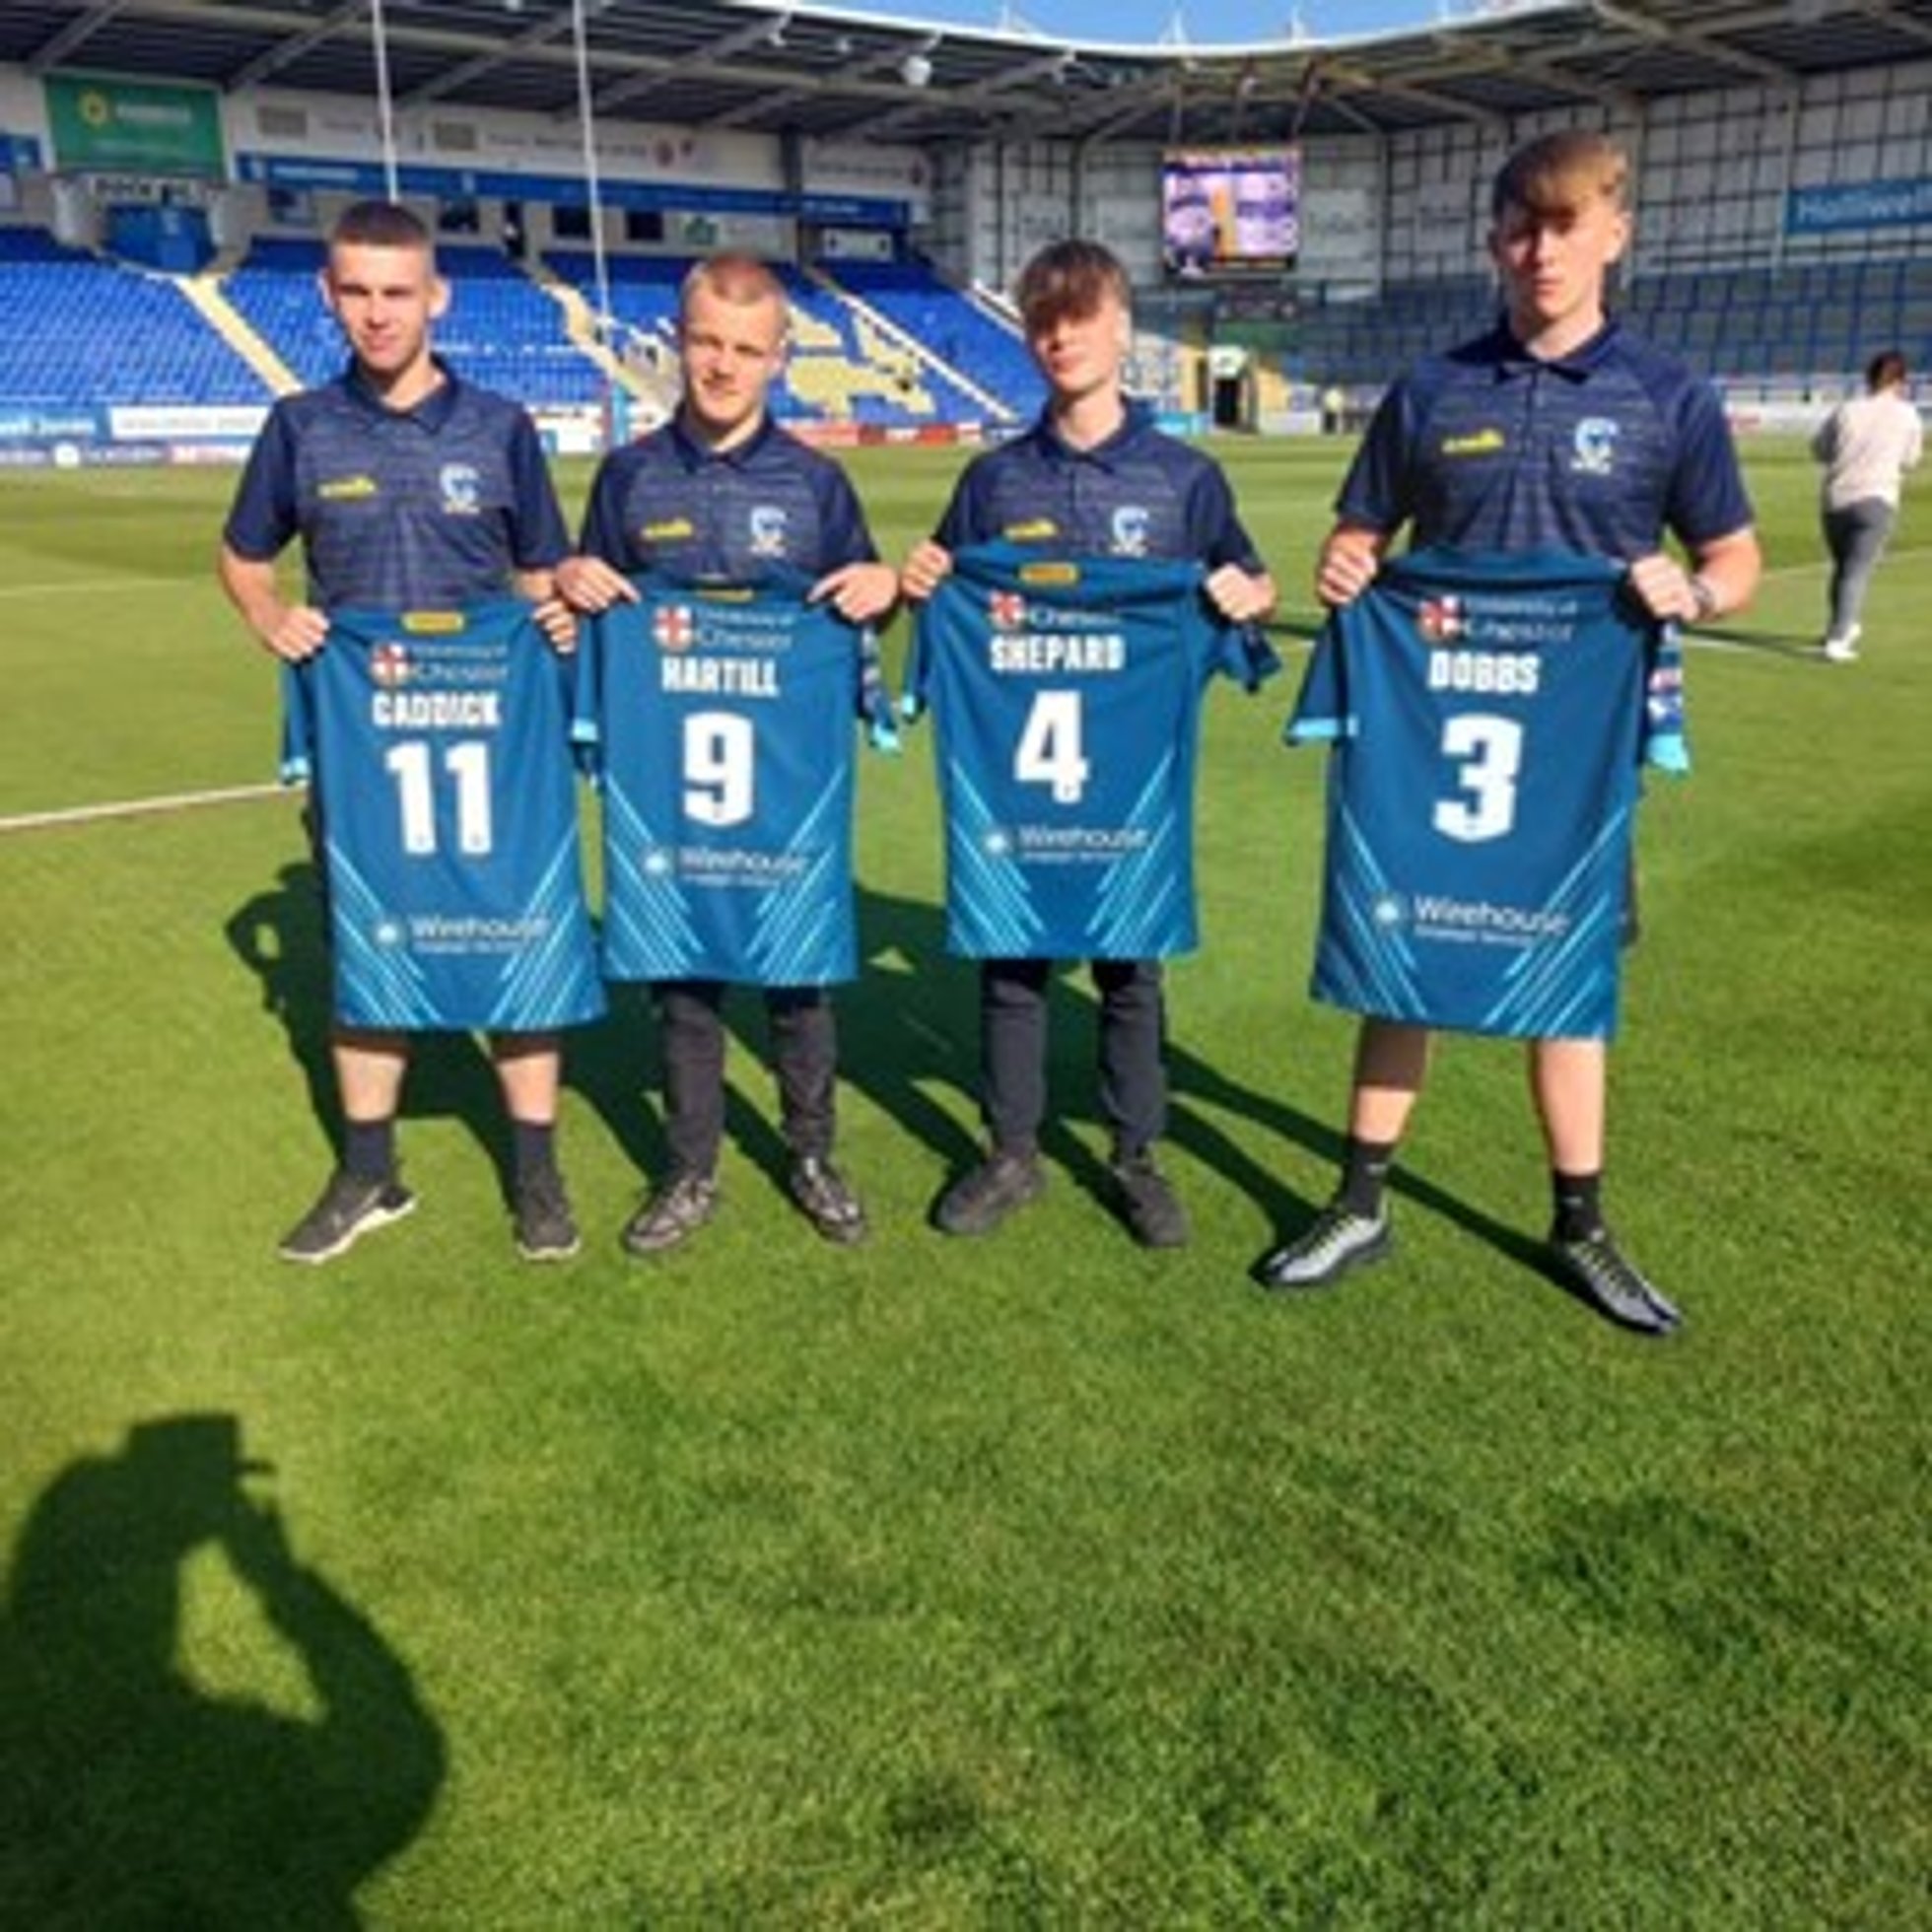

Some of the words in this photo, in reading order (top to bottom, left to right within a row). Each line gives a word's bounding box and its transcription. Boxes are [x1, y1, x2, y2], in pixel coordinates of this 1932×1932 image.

[660, 656, 781, 698] HARTILL
[989, 635, 1128, 672] SHEPARD
[1428, 649, 1542, 694] DOBBS
[372, 691, 501, 727] CADDICK
[1013, 688, 1090, 804] 4
[384, 740, 493, 855] 11
[683, 711, 754, 826] 9
[1432, 712, 1524, 843] 3
